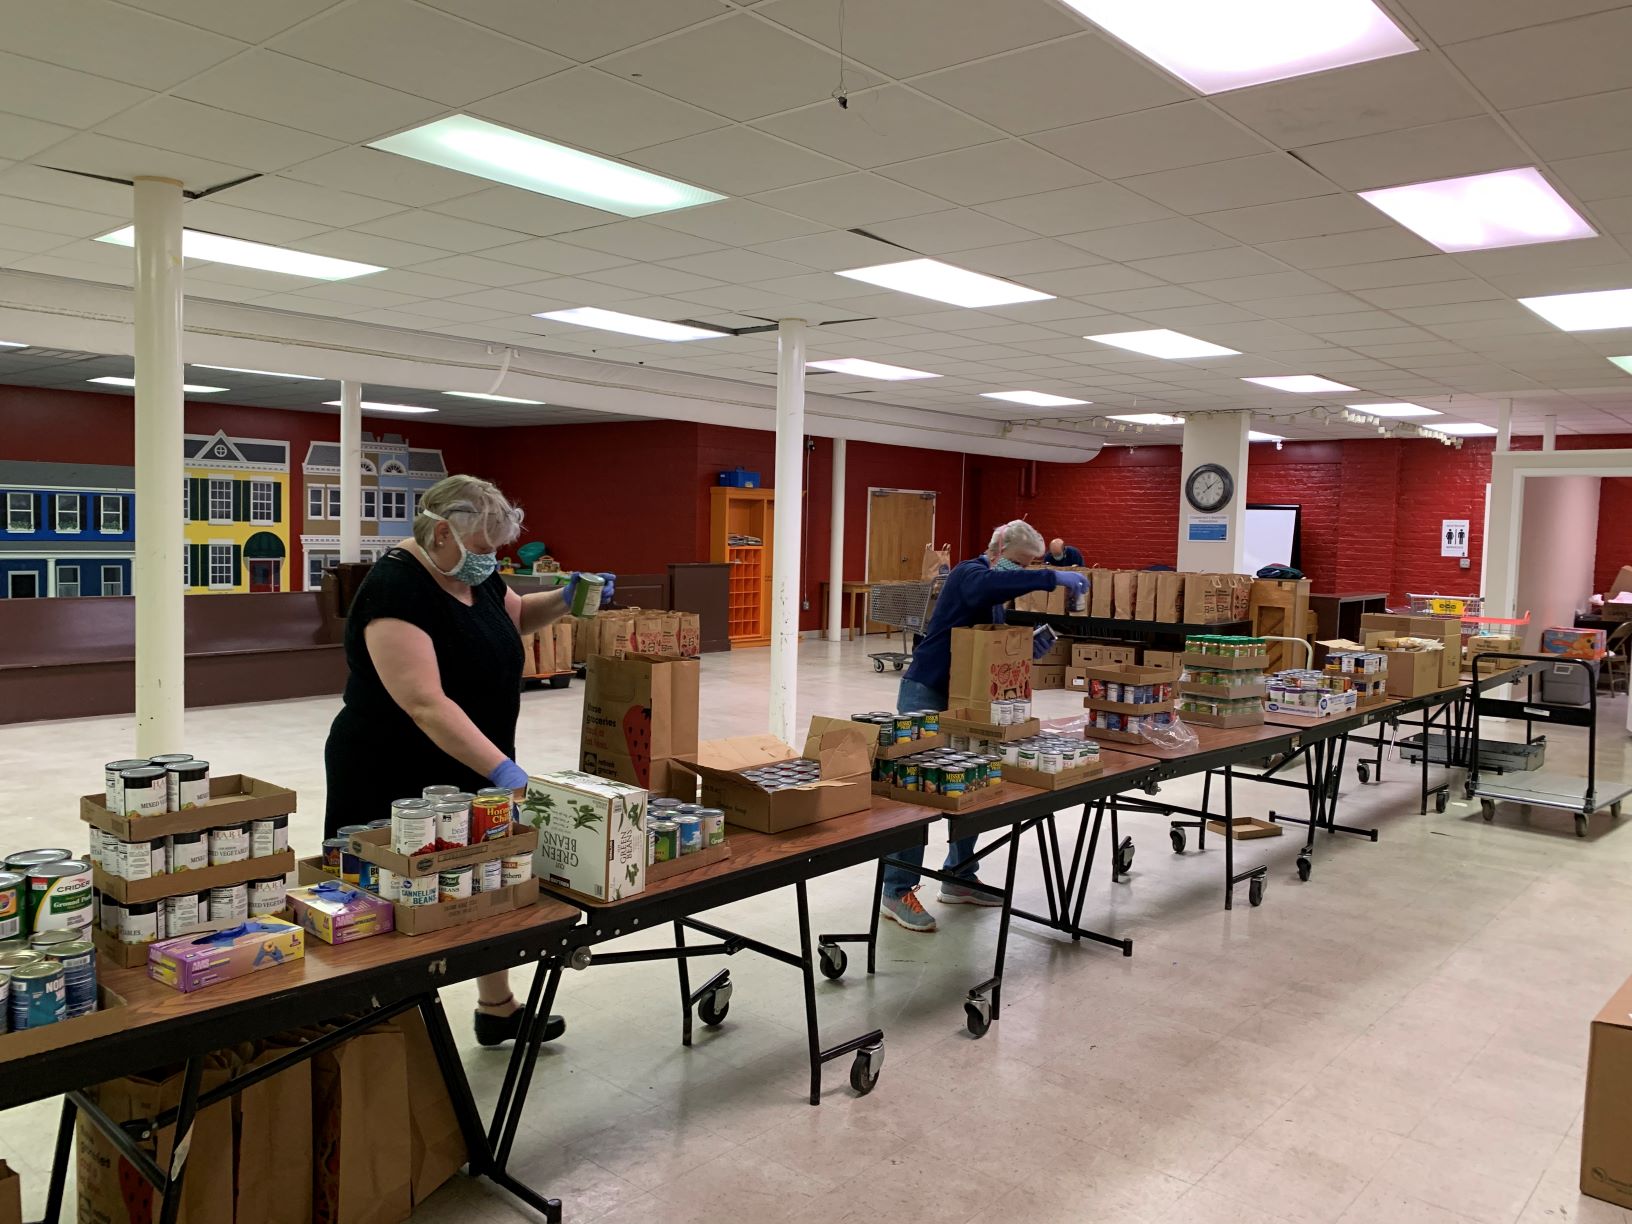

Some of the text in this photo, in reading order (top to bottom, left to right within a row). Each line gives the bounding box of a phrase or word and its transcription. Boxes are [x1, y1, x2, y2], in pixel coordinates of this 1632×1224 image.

[586, 715, 617, 727] groceries
[946, 773, 965, 781] MISSION
[141, 801, 159, 810] MIXED
[544, 831, 577, 852] BEANS
[542, 843, 579, 868] GREEN
[56, 879, 91, 893] CRIDER
[53, 899, 80, 909] Ground
[413, 894, 437, 904] BEANS
